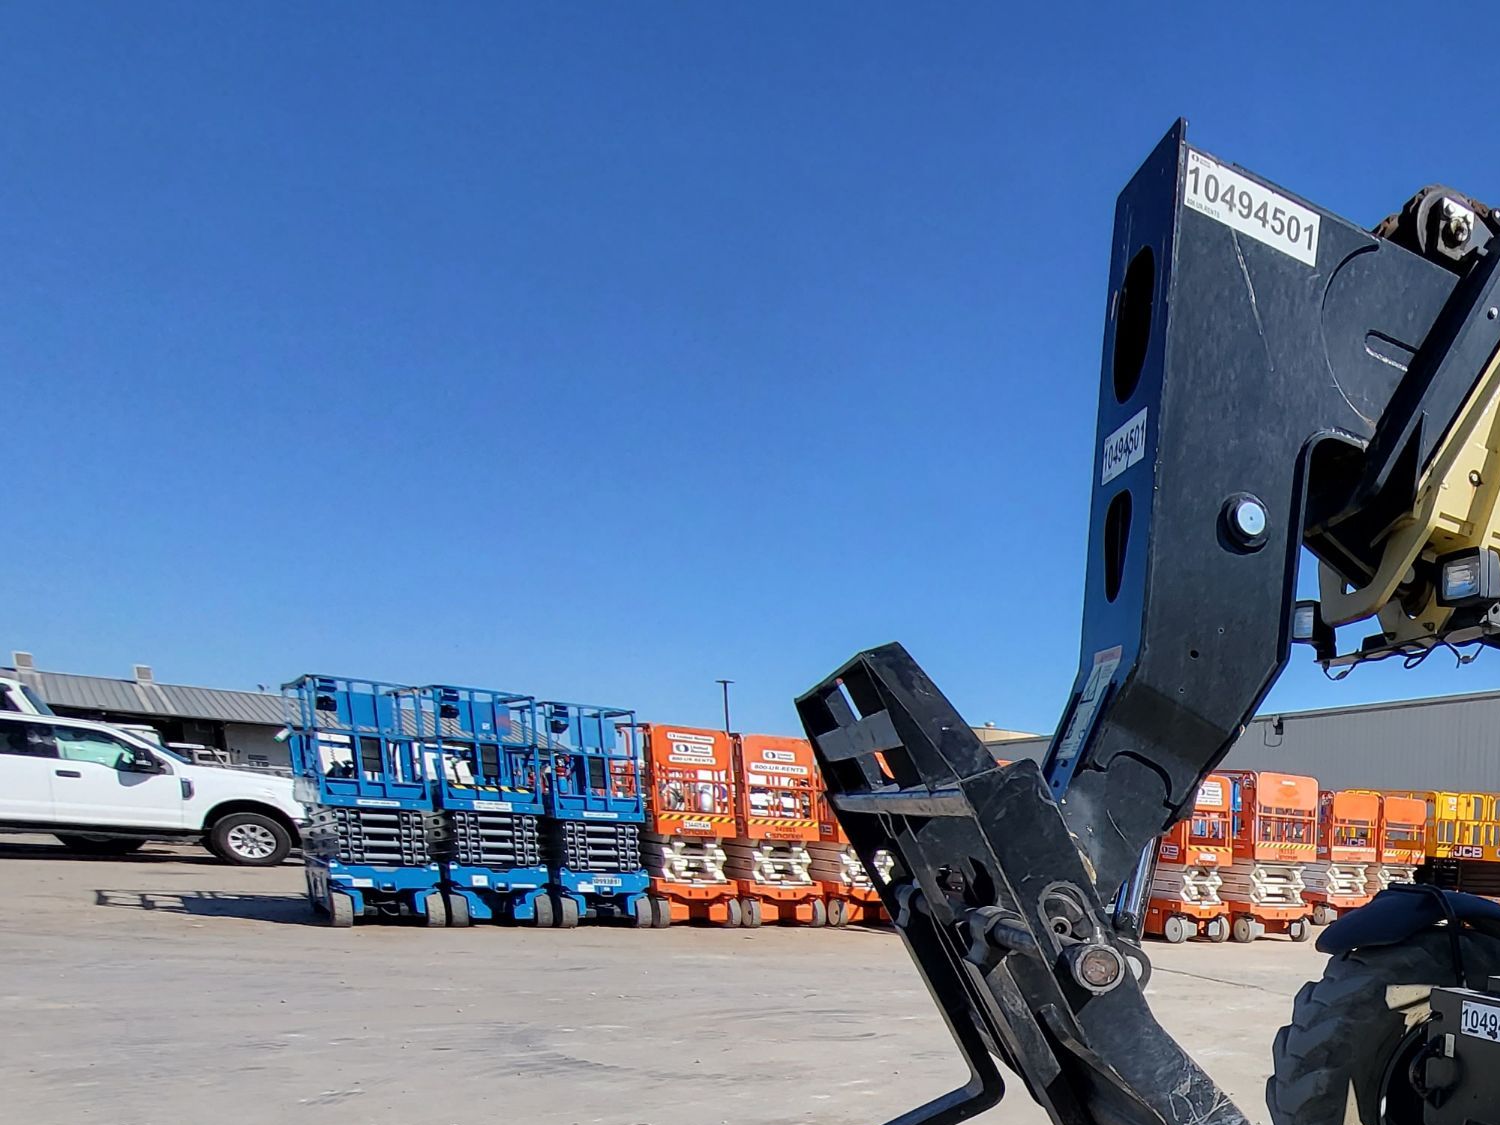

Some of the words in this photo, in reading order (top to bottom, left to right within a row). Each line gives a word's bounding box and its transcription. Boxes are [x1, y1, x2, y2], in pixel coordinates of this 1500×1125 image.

[1189, 166, 1315, 252] 10494501
[1104, 420, 1145, 473] 10494501
[1454, 845, 1483, 858] JCB
